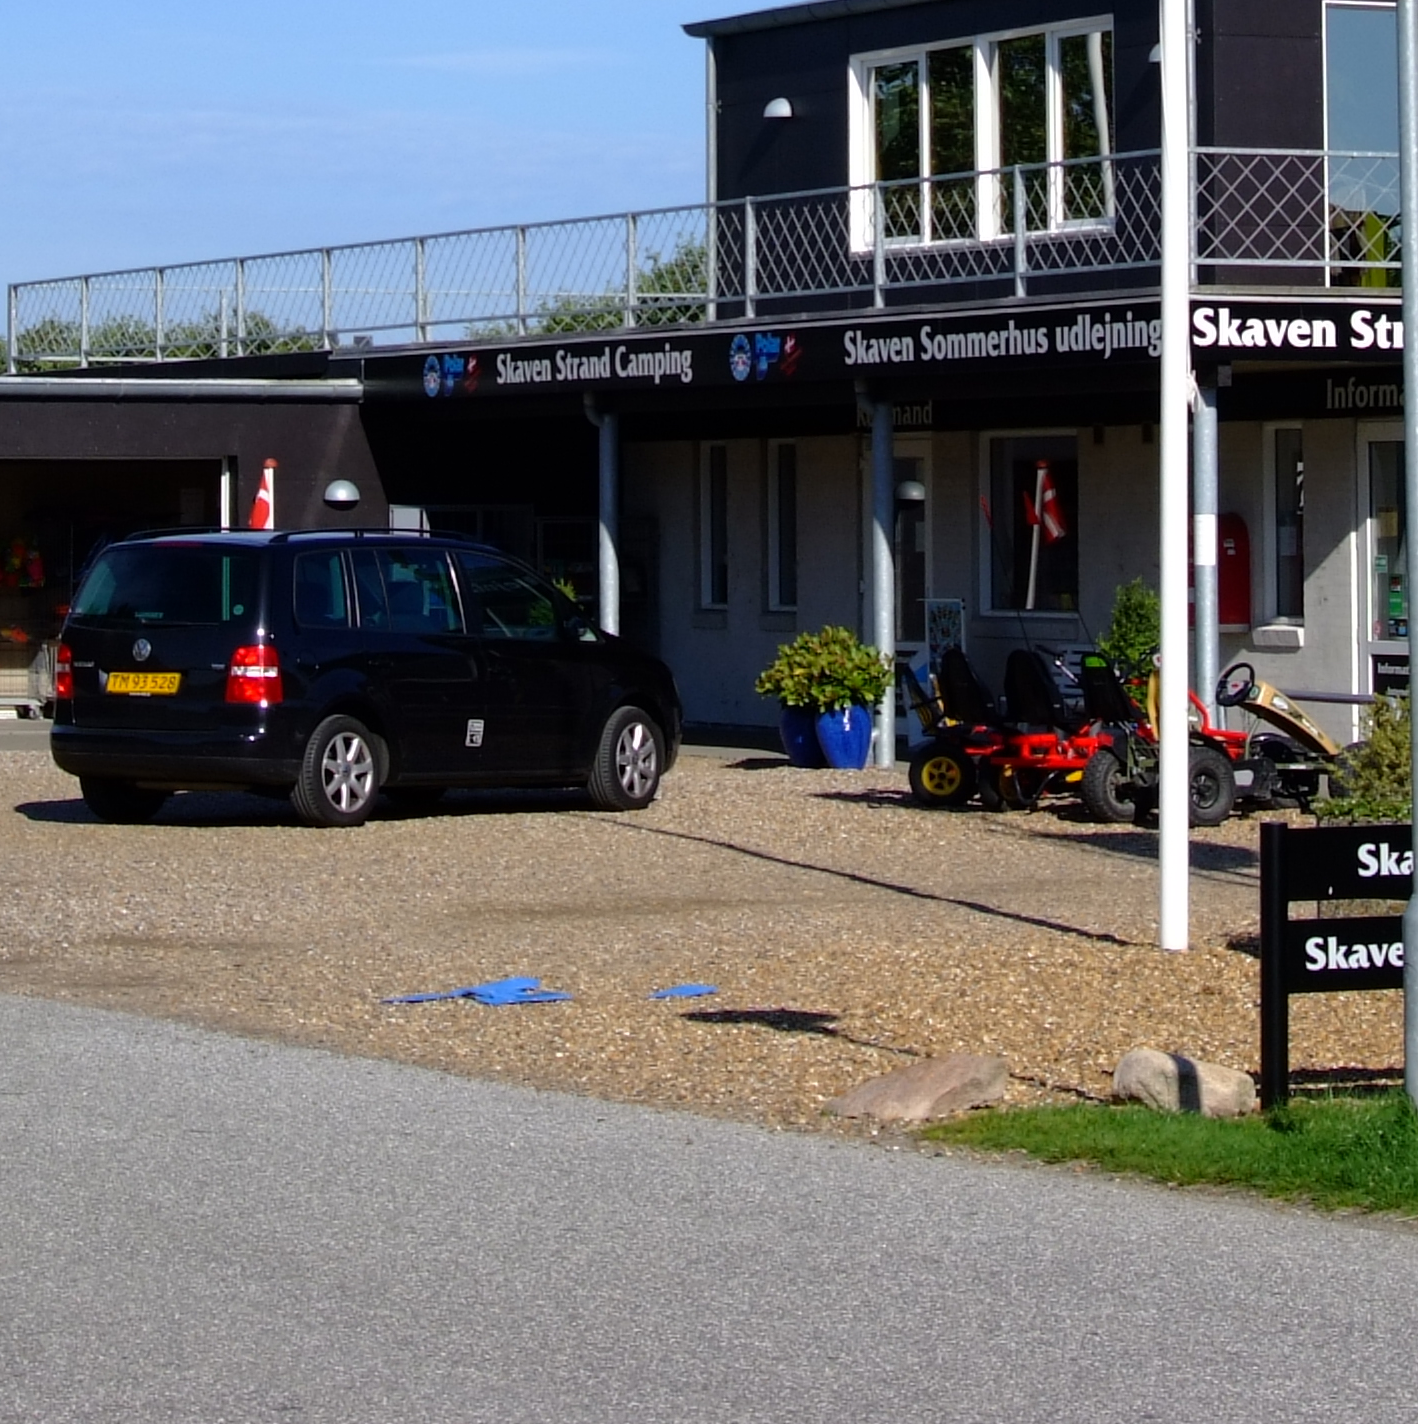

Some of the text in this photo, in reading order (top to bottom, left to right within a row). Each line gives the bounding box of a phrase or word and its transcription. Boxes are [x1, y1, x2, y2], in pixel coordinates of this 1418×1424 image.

[843, 310, 1162, 365] Skaven Sommerhus udlejning
[1192, 307, 1337, 349] Skaven
[496, 342, 693, 384] Skaven Strand Camping
[856, 399, 933, 427] Kmand
[112, 675, 177, 689] TM 93 528
[1305, 936, 1405, 971] Skave
